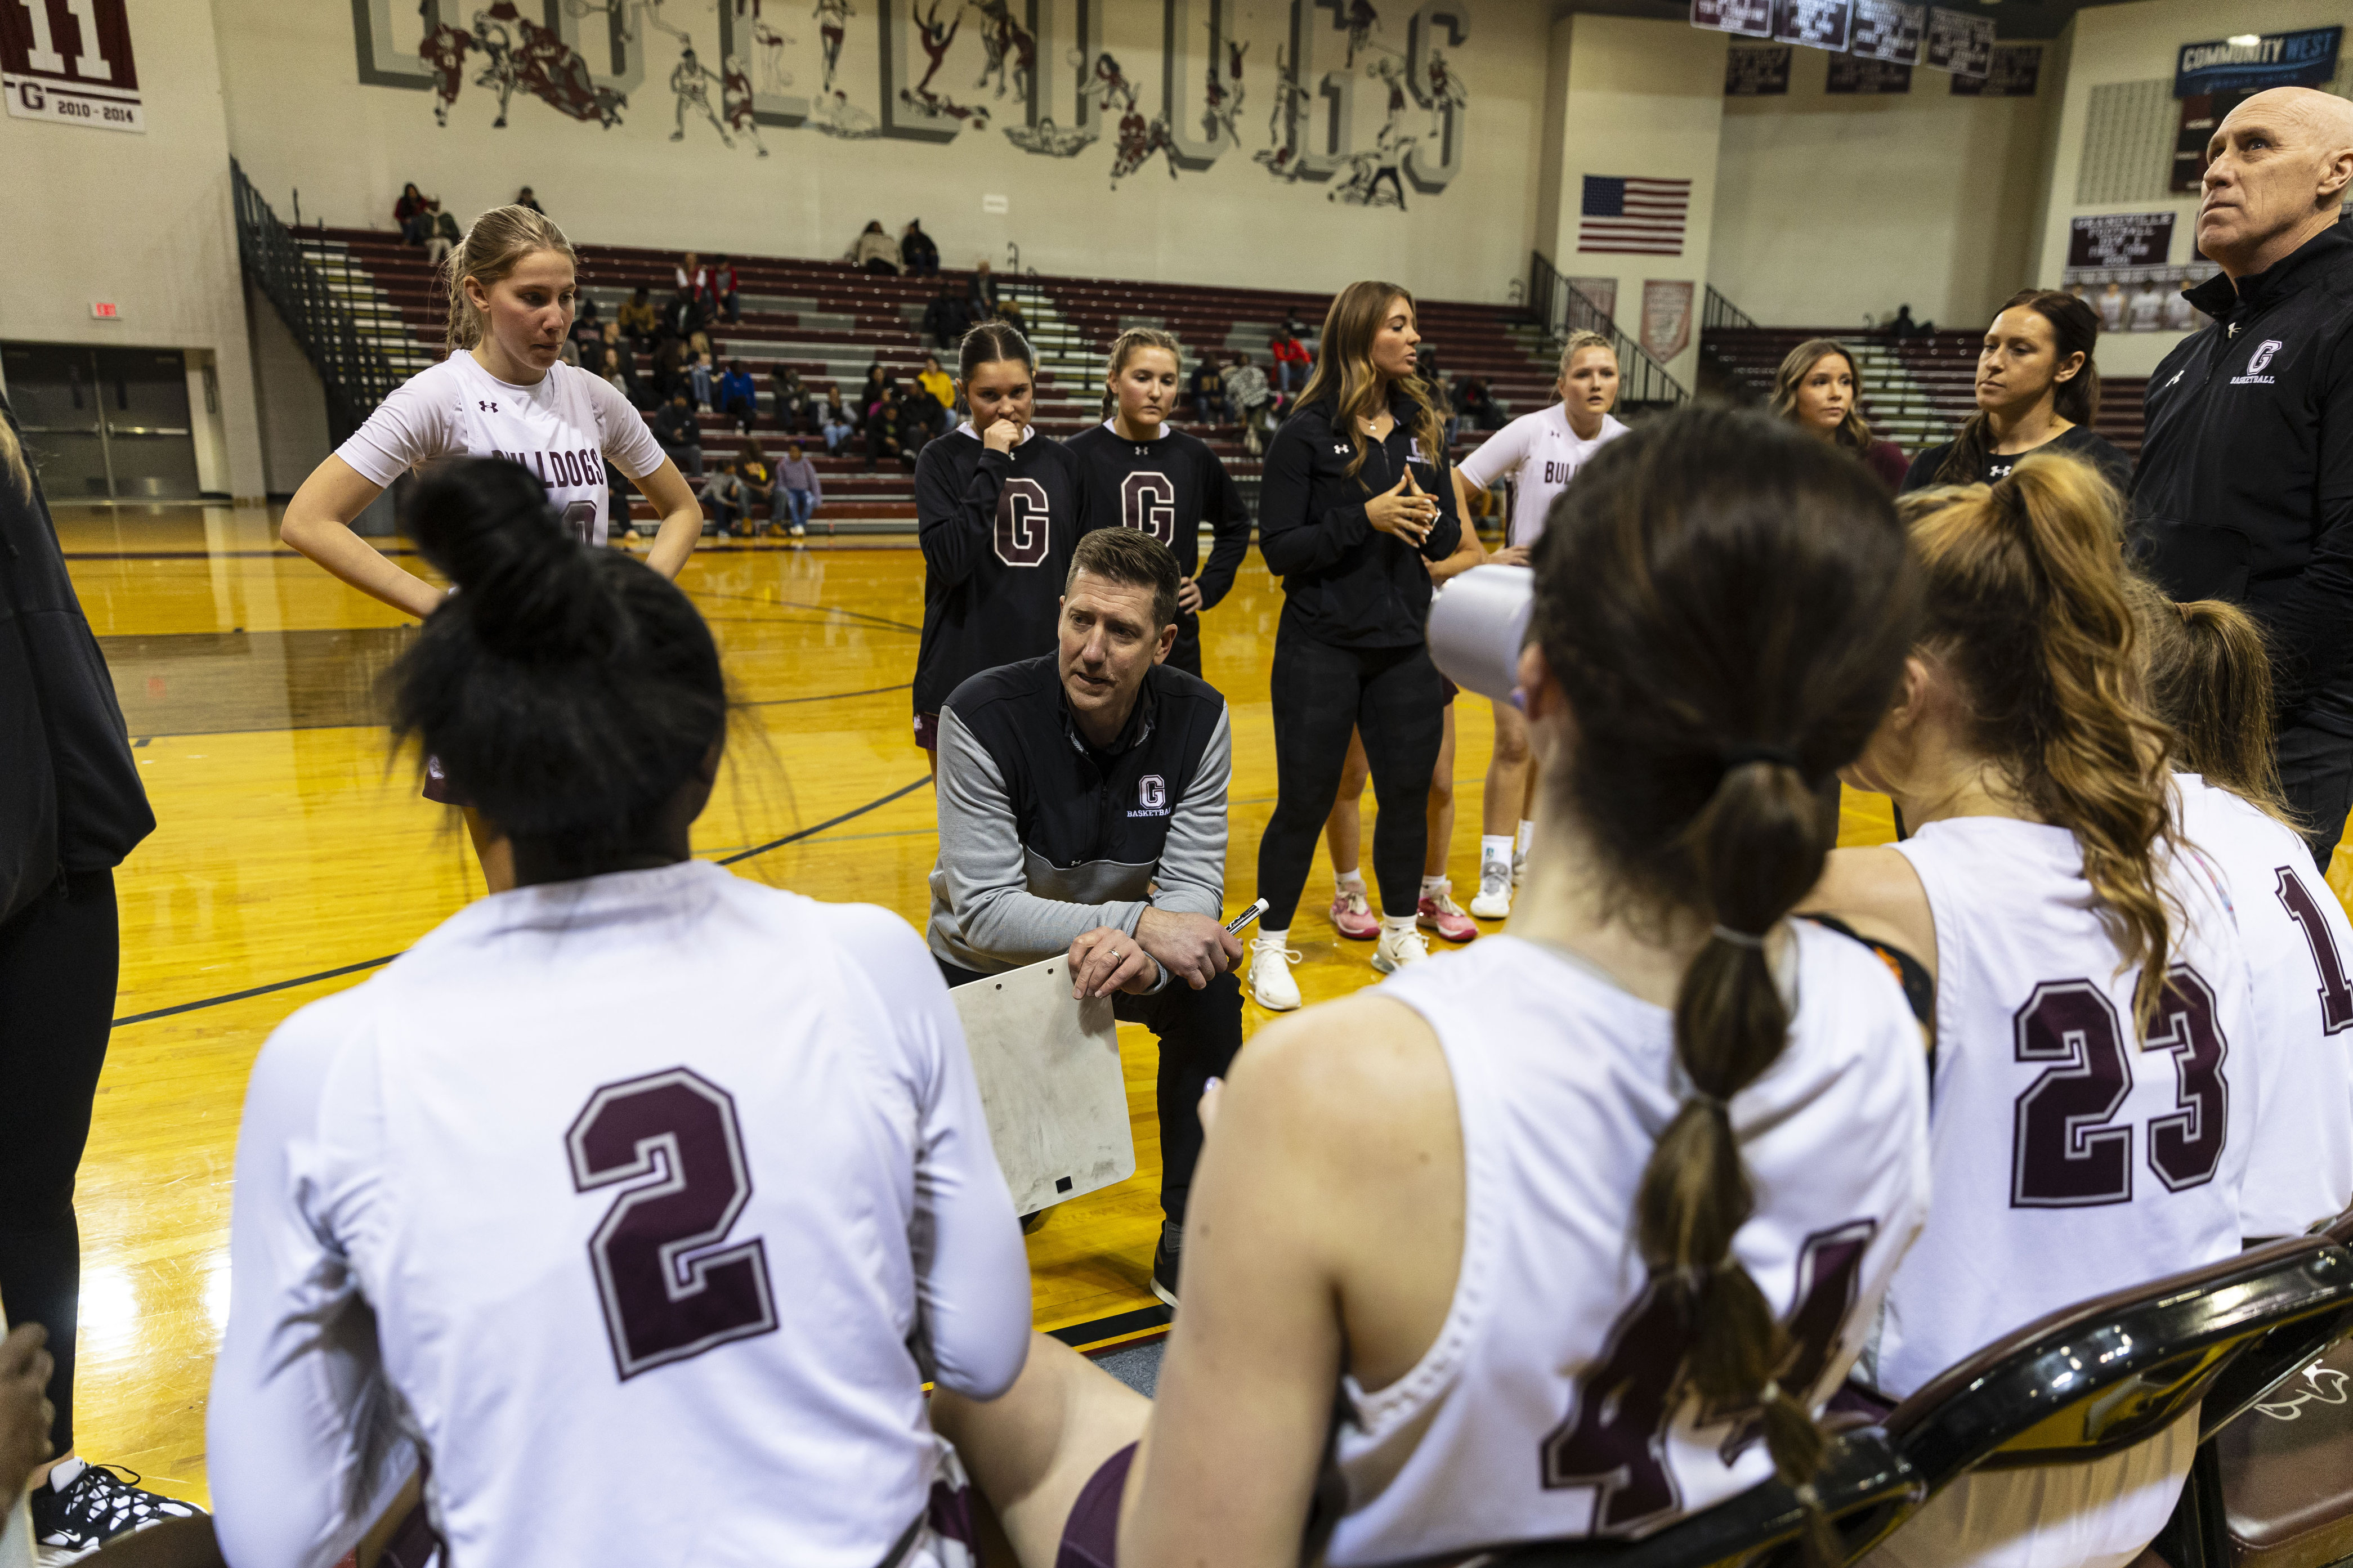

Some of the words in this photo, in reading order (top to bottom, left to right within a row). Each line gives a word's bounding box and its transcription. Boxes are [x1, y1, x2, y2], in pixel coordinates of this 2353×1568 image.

[20, 0, 112, 80] 11
[2182, 37, 2285, 73] COMMUNITY
[21, 82, 46, 110] G
[59, 101, 91, 117] 2010
[104, 107, 134, 123] 2014
[2247, 339, 2282, 376] G
[2230, 375, 2275, 384] BASKETBALL
[994, 477, 1049, 567] G
[1121, 471, 1175, 547] G
[1139, 774, 1165, 809] G
[2010, 962, 2228, 1208] 23
[565, 1065, 779, 1383] 2
